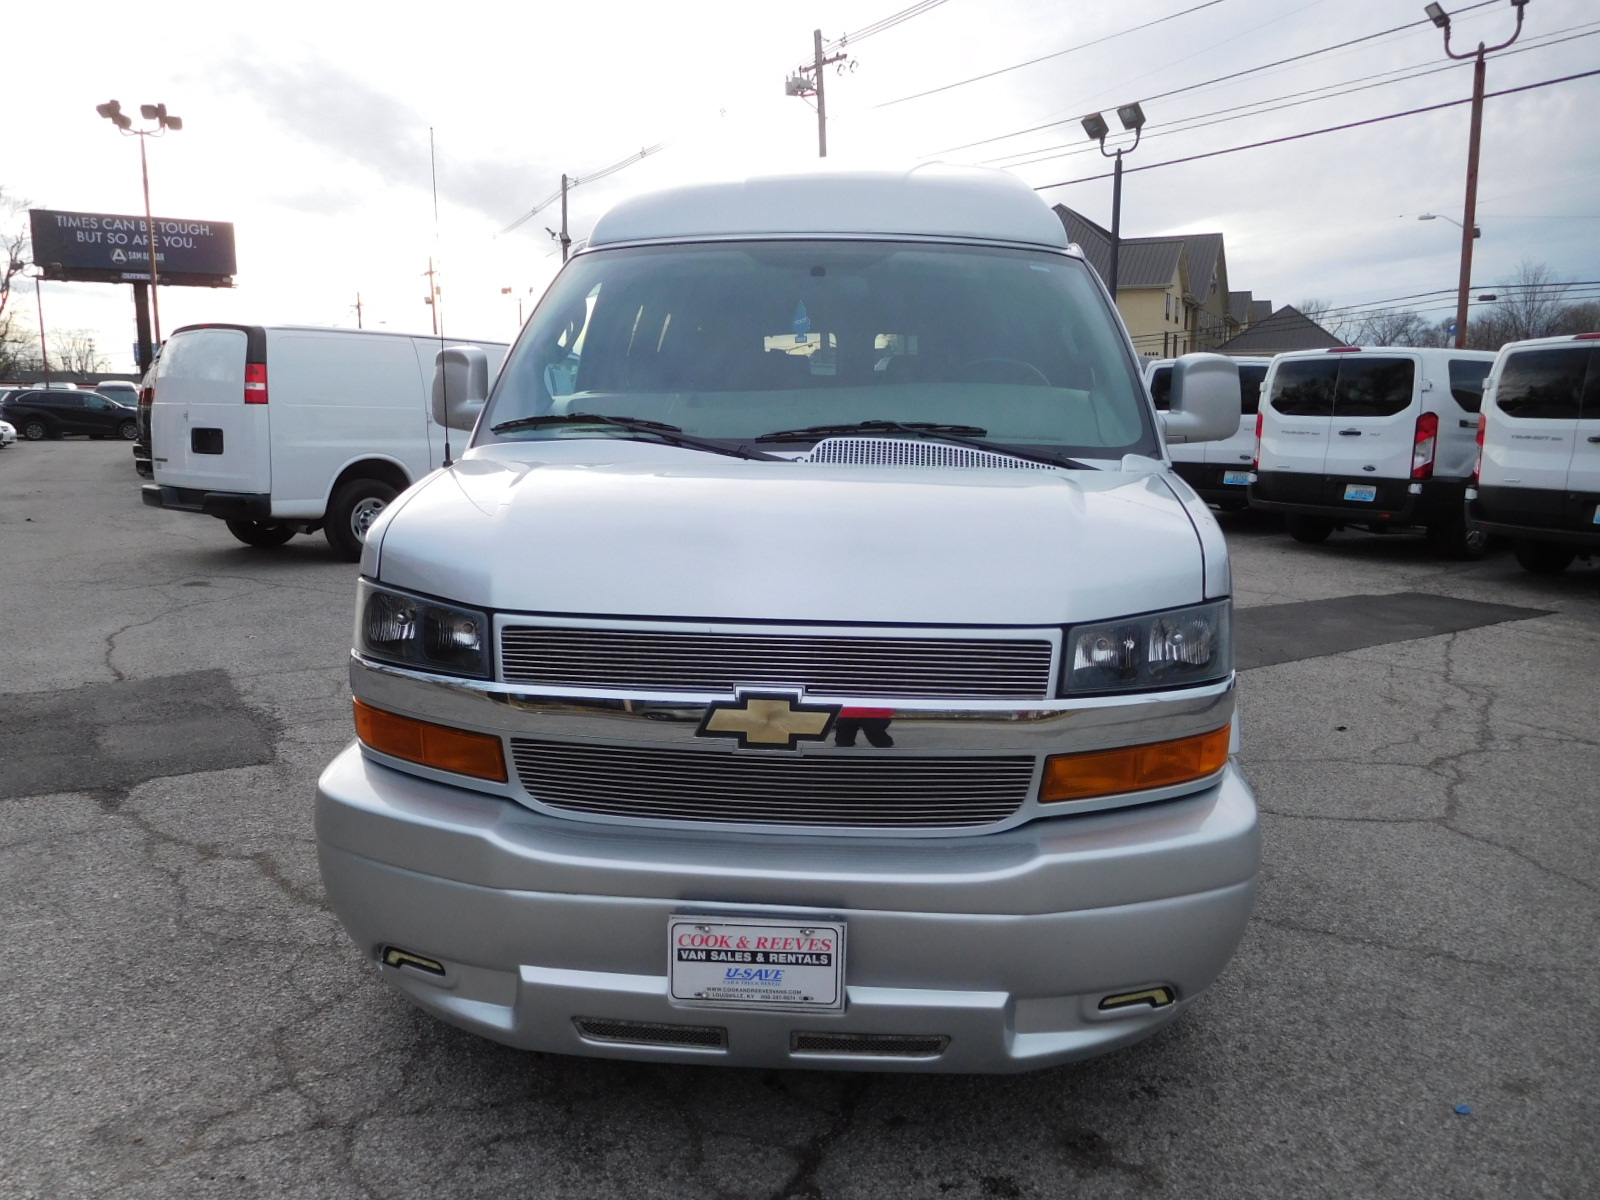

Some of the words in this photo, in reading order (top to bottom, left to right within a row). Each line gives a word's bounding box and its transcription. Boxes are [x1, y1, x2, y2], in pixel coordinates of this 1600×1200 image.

[55, 214, 98, 229] TIMES
[102, 218, 135, 231] CAN
[140, 220, 156, 233] BE
[159, 221, 214, 236] TOUGH.
[76, 230, 103, 243] BUT
[106, 232, 128, 245] SO
[132, 233, 159, 247] ARE
[162, 235, 197, 249] YOU.
[678, 933, 733, 948] COOK
[736, 935, 751, 950] &
[755, 936, 832, 952] REEVES
[680, 949, 706, 960] VAN
[710, 950, 752, 962] SALES
[755, 952, 766, 963] &
[769, 953, 829, 965] RENTALS
[725, 967, 783, 981] U-SAVE
